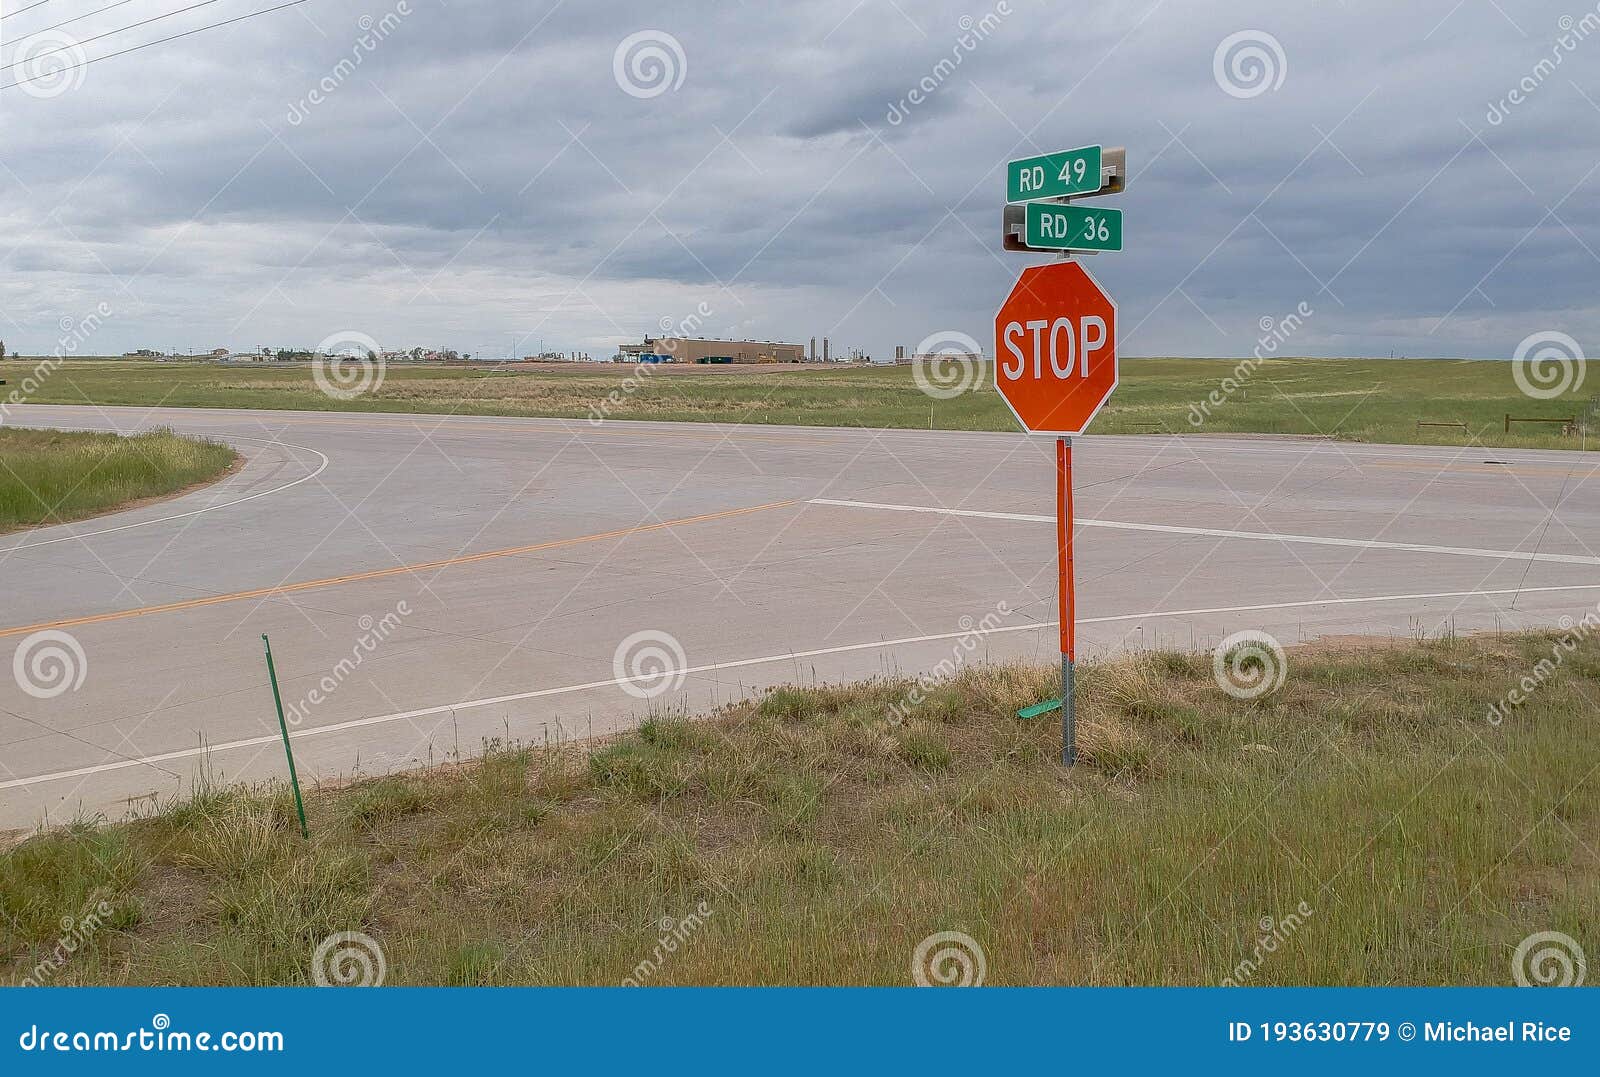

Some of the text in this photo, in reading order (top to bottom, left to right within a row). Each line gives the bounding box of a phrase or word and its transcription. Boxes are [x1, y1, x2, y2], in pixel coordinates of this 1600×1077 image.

[1019, 158, 1087, 192] RD 49
[1040, 213, 1110, 242] RD 36
[1002, 315, 1107, 381] STOP
